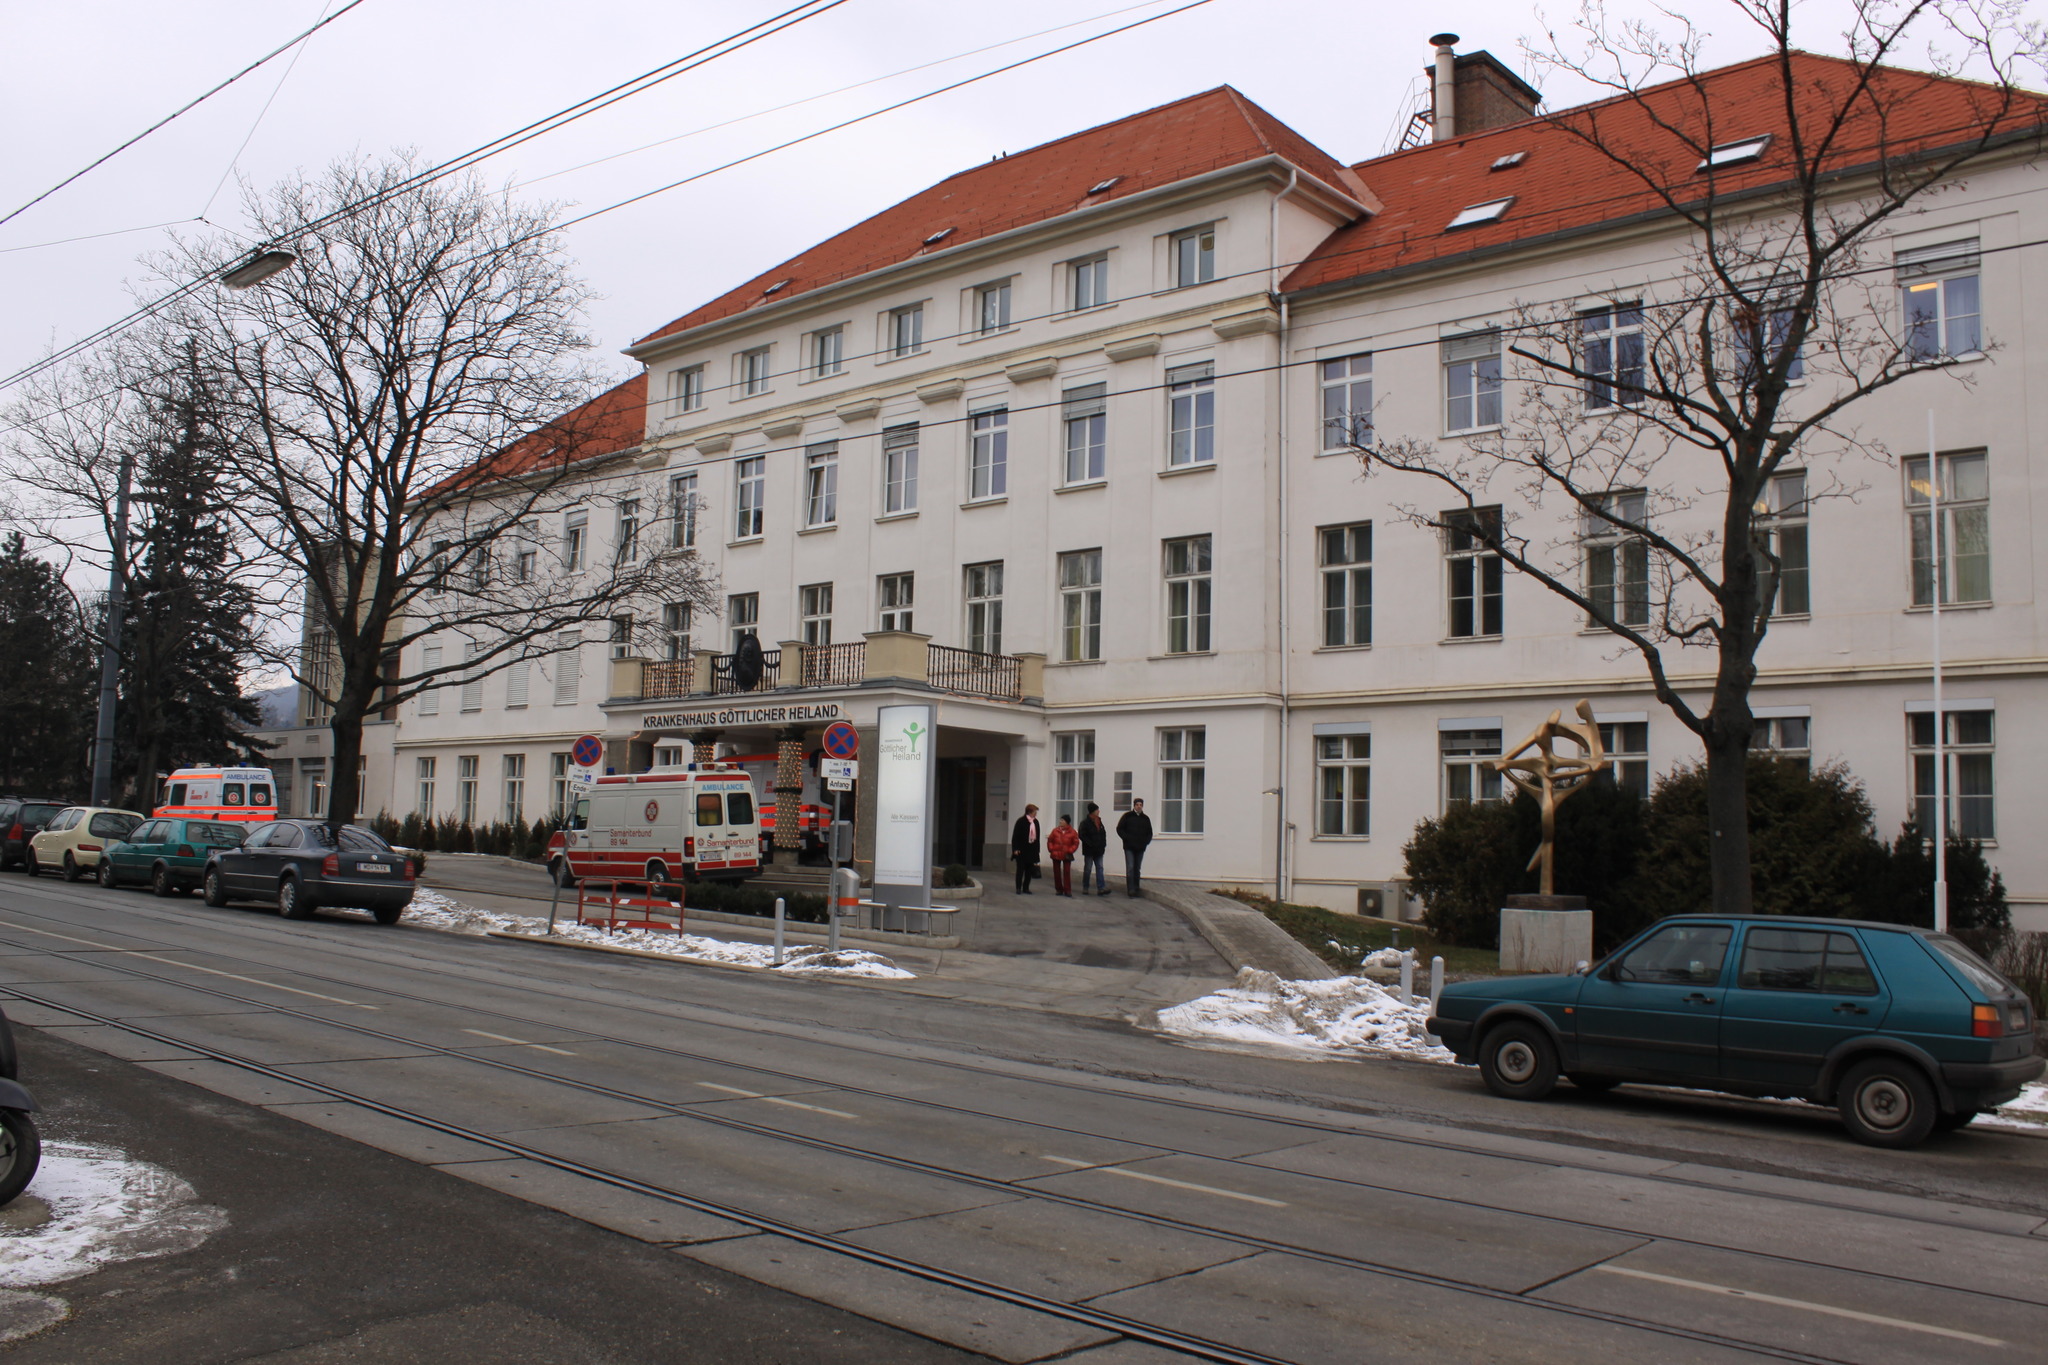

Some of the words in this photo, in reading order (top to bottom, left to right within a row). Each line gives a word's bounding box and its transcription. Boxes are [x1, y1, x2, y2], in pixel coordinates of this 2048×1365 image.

[643, 712, 716, 728] KRANKENHAUS
[719, 708, 786, 725] GÖTTLICHER
[789, 704, 839, 720] HEILAND
[880, 744, 907, 753] Göttlicher
[893, 752, 921, 760] Heiland
[829, 781, 850, 789] Anfang
